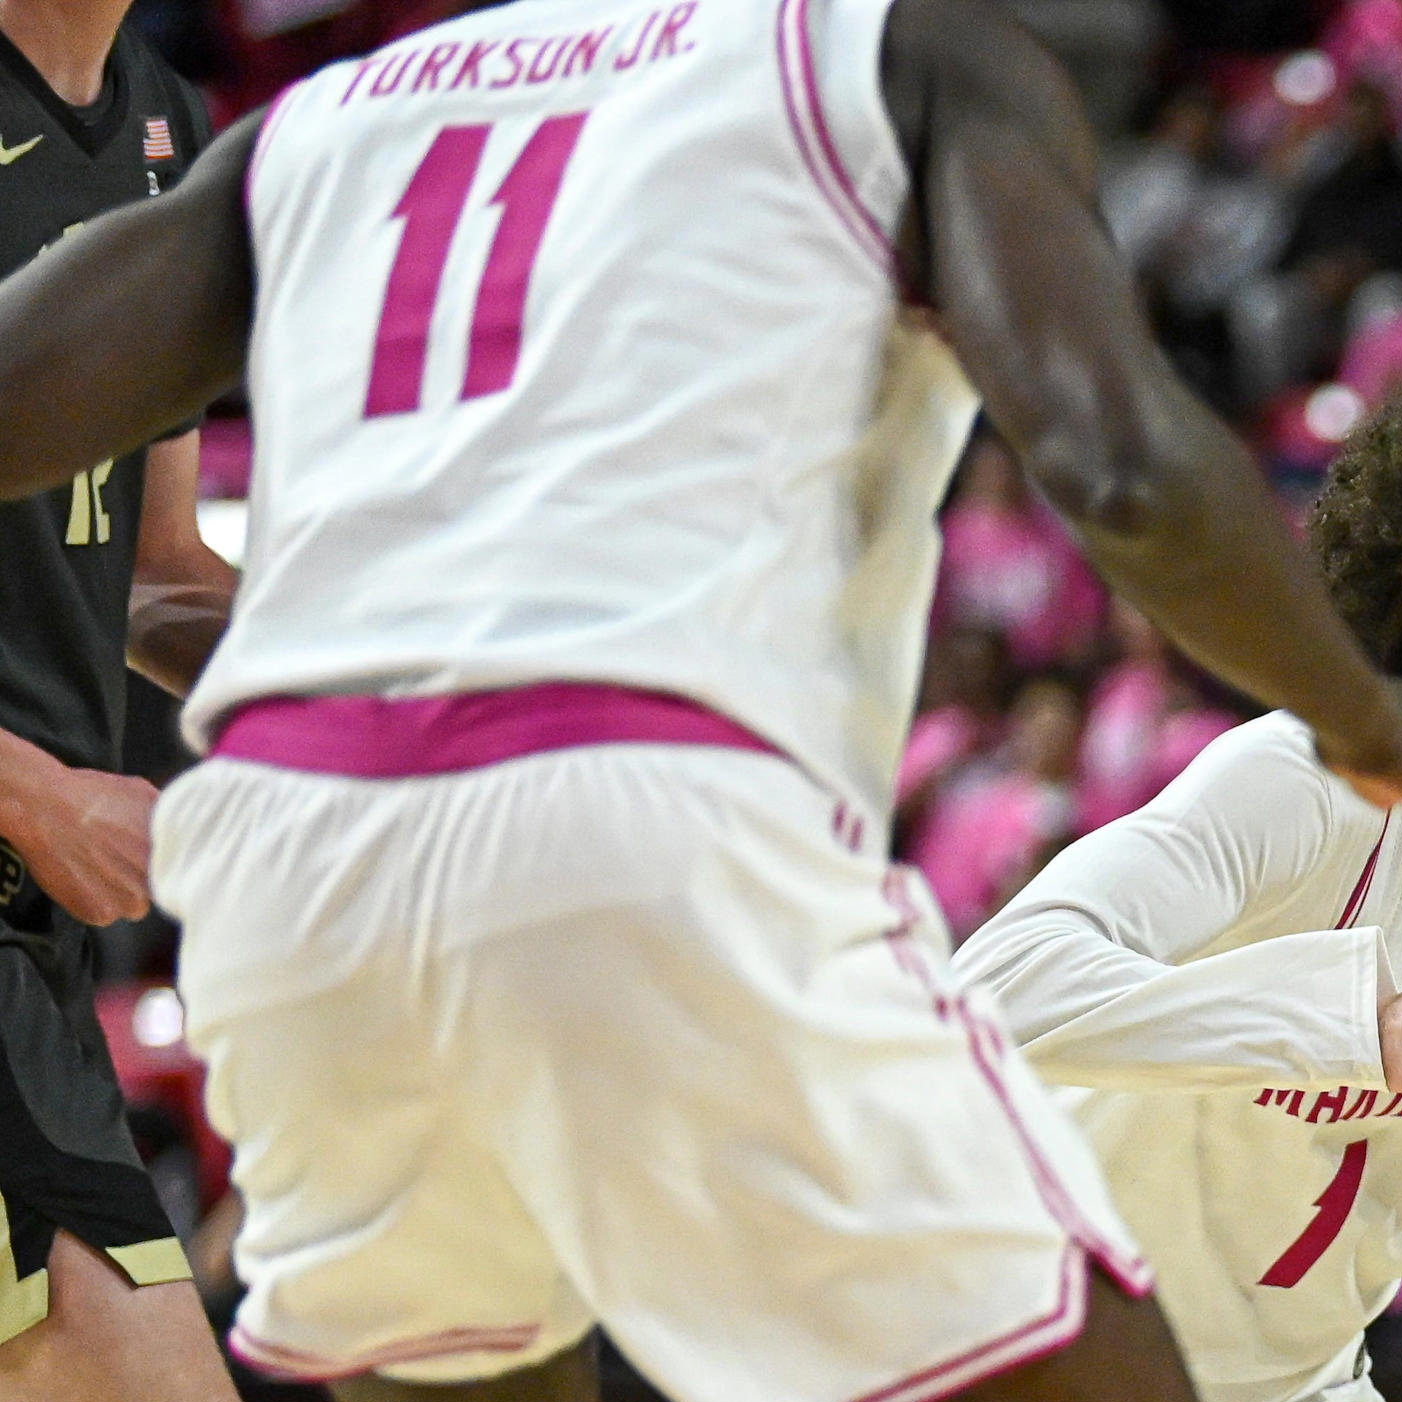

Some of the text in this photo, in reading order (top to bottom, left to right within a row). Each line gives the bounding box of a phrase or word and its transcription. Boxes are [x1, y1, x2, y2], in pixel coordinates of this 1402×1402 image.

[612, 1, 700, 71] JR.
[362, 110, 591, 421] 11
[1256, 1138, 1368, 1289] 1
